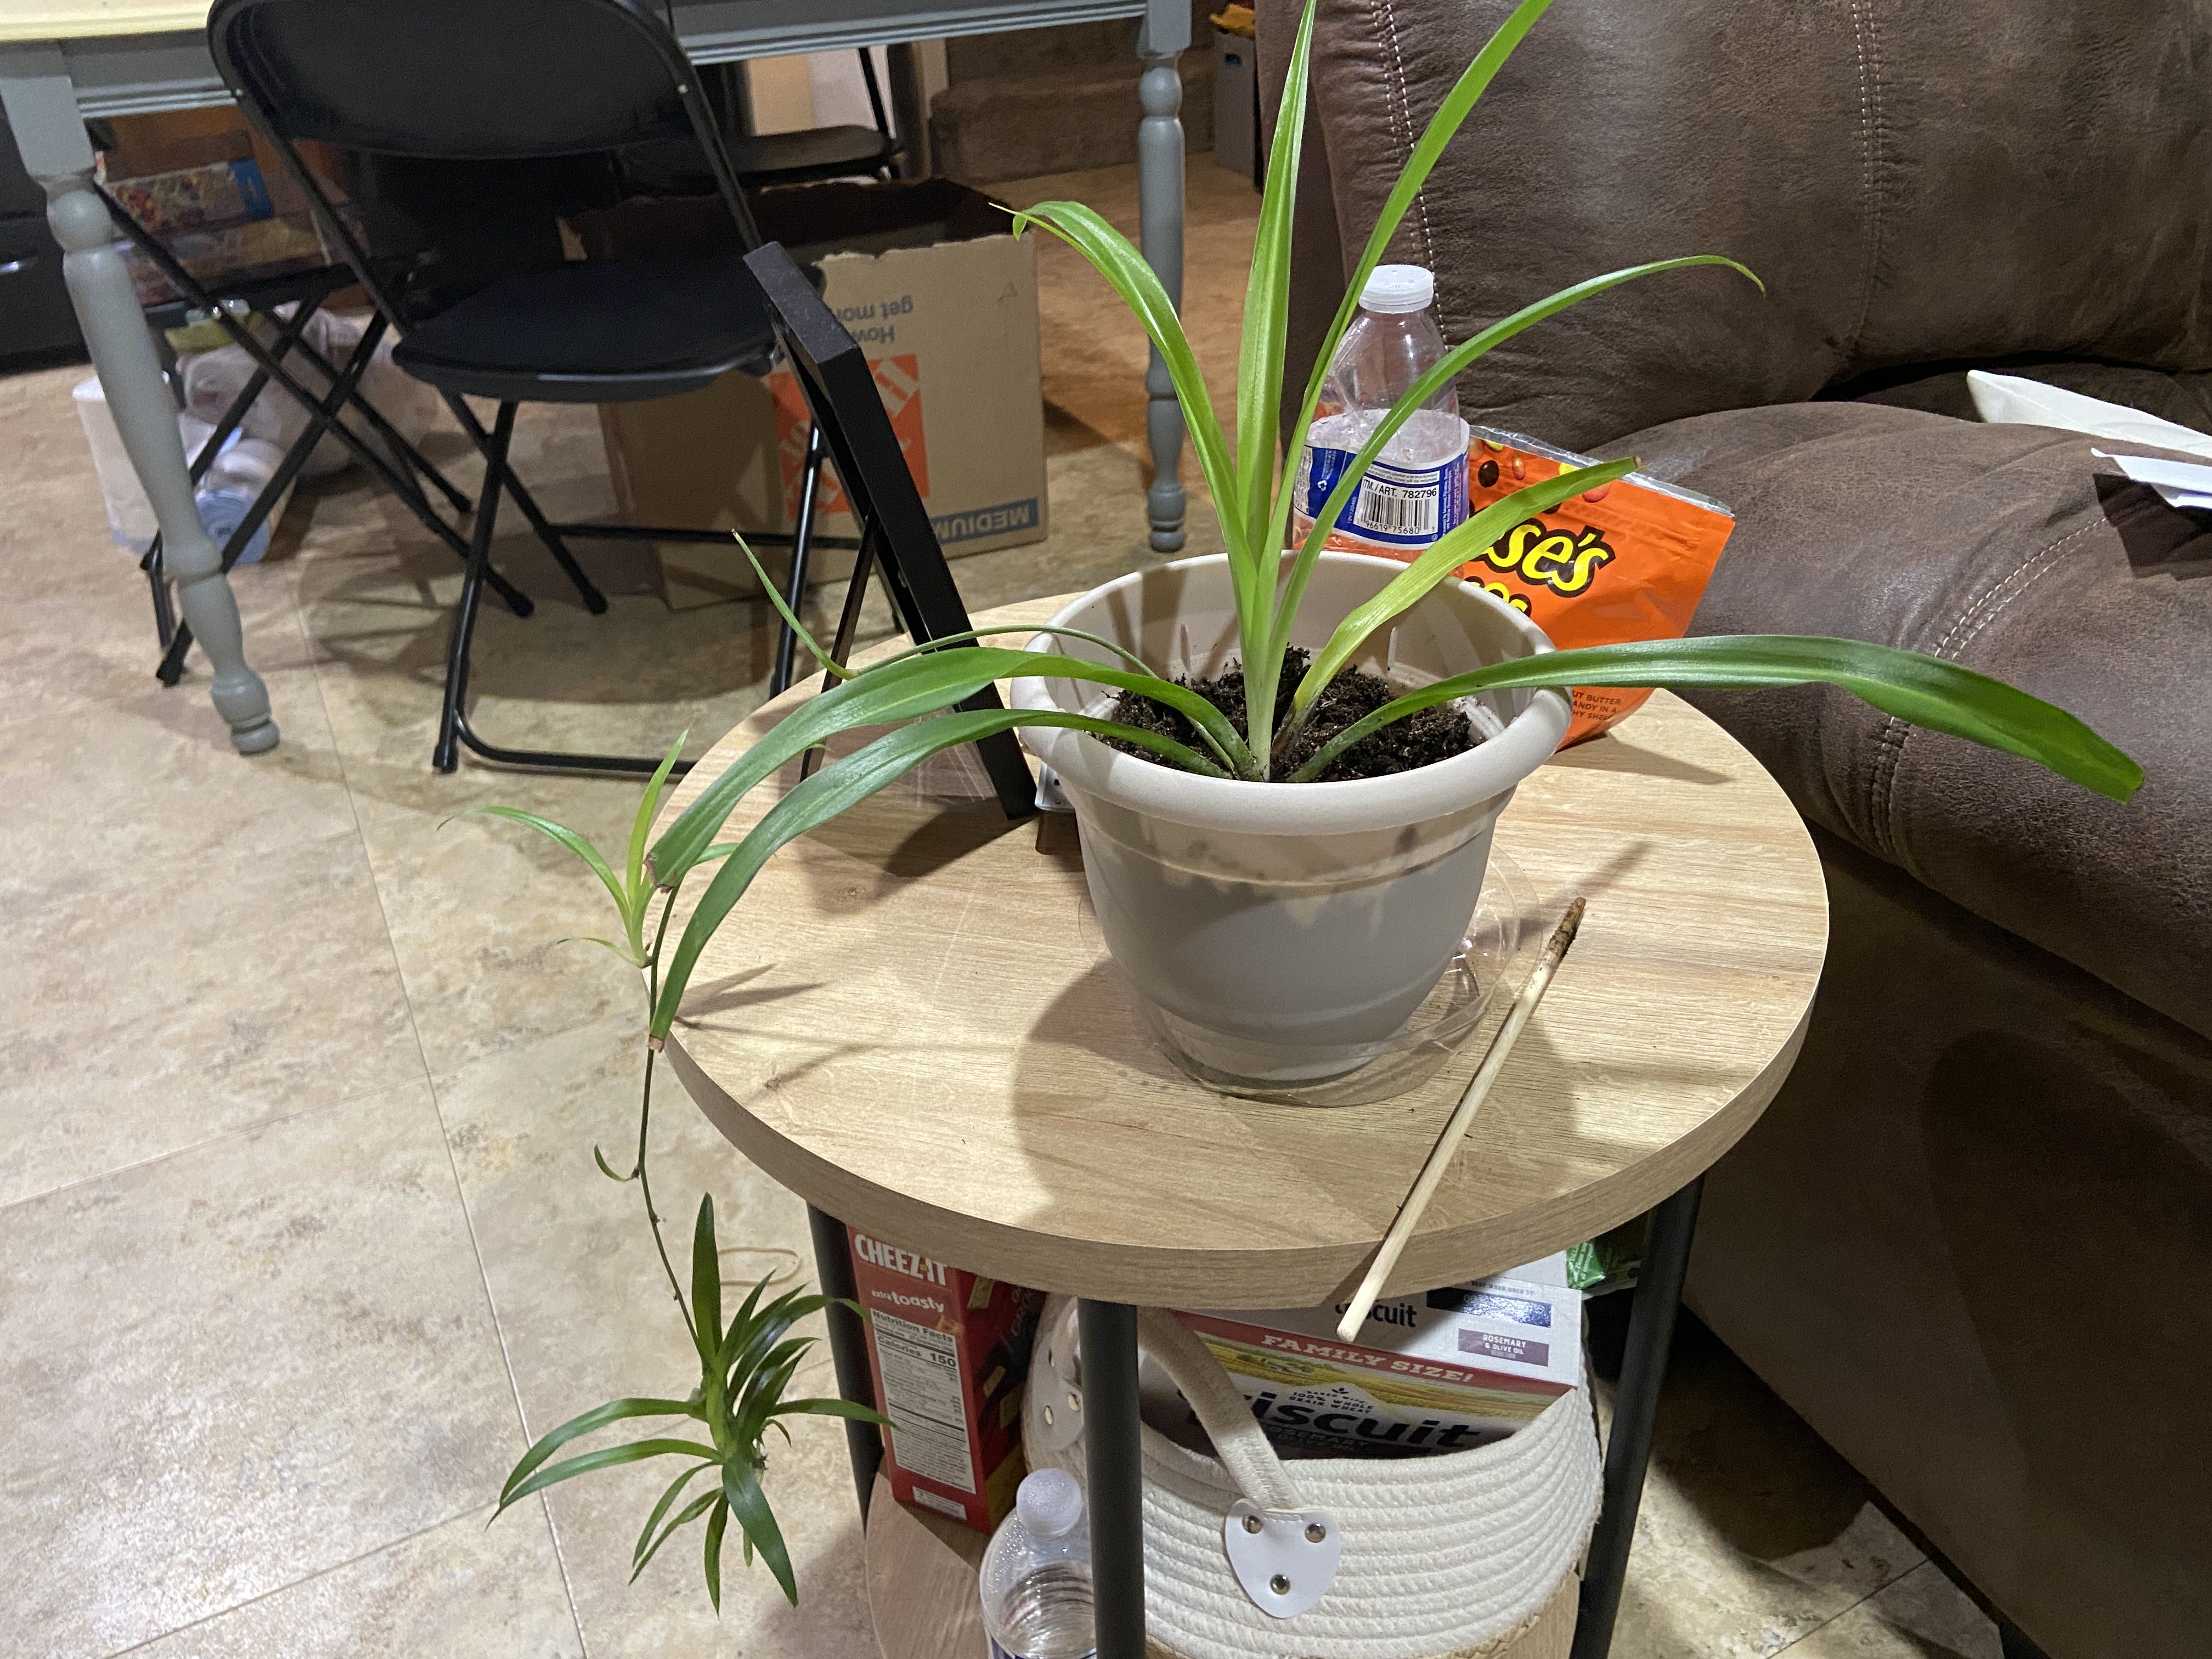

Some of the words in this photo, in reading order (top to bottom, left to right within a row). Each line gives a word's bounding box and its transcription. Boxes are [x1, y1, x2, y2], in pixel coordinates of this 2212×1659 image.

[882, 295, 913, 320] get
[1402, 488, 1437, 499] 782796
[1365, 521, 1388, 532] 96619
[1392, 526, 1420, 534] 75680
[1482, 524, 1609, 591] se's
[1572, 690, 1584, 699] UT
[1587, 695, 1621, 704] BUTTER
[1573, 701, 1598, 711] ANDY
[871, 1290, 892, 1301] extra
[891, 1291, 945, 1313] toasty
[872, 1311, 920, 1331] Nutrition
[923, 1328, 953, 1342] Facts
[1483, 1334, 1526, 1348] ROSEMARY
[1492, 1344, 1511, 1352] OLIVE
[878, 1336, 921, 1357] Calories
[929, 1353, 956, 1368] 150
[1261, 1335, 1386, 1365] FAMILY
[1391, 1360, 1474, 1383] SIZE!
[1289, 1396, 1325, 1406] GRAIN
[1331, 1404, 1371, 1413] WHEAT
[1293, 1392, 1325, 1401] 100%
[1334, 1400, 1374, 1409] WHOLE
[1243, 1391, 1480, 1448] iscuit
